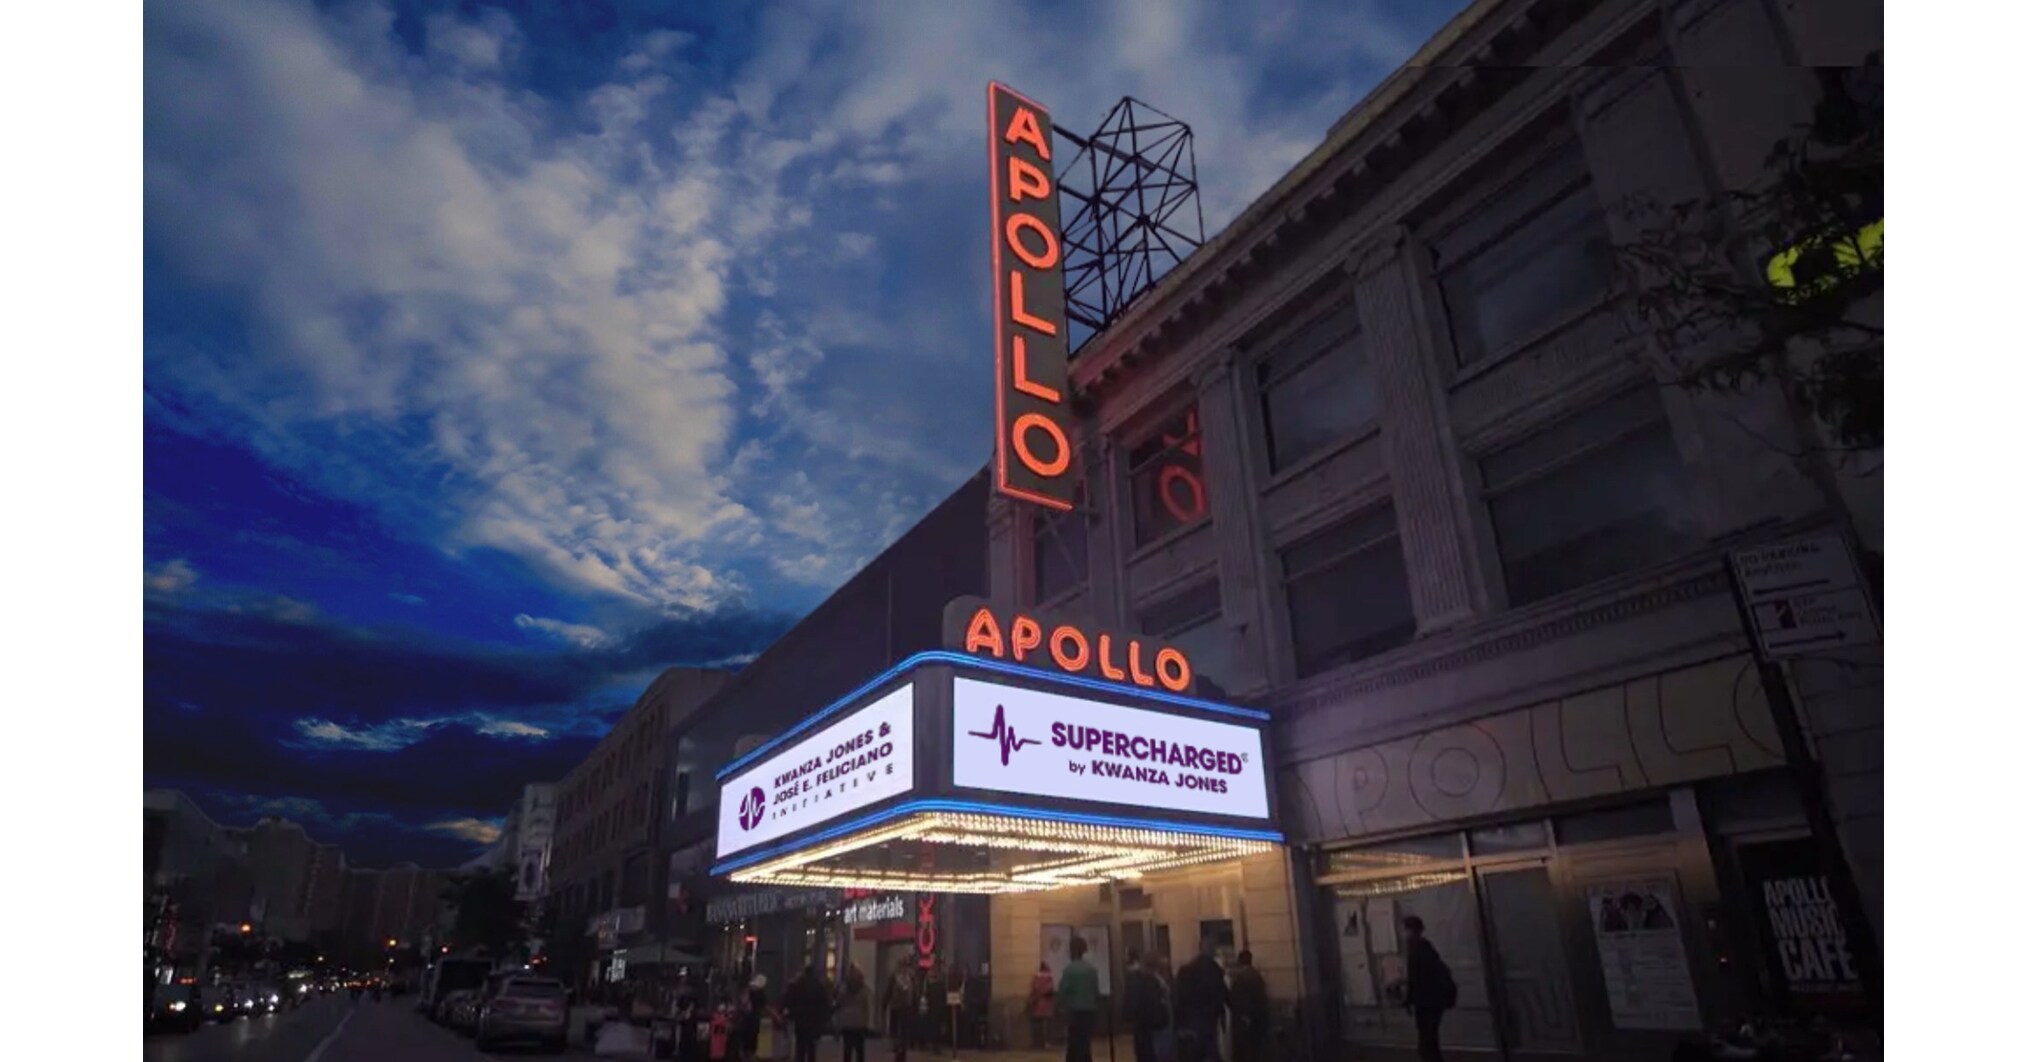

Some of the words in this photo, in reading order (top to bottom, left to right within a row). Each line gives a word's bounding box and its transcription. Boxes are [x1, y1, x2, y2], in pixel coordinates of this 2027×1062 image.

[1004, 105, 1071, 477] APOLLO
[966, 608, 1191, 691] APOLLO
[772, 780, 799, 806] JOSÉ
[802, 780, 813, 793] E.
[816, 742, 893, 787] FELICIANO
[773, 756, 822, 789] KWANZA
[826, 729, 873, 764] JONES
[879, 721, 892, 738] &
[1068, 760, 1086, 776] by
[1091, 760, 1170, 786] KWANZA
[1174, 773, 1228, 794] JONES
[772, 763, 894, 820] INITIATIVE
[858, 894, 904, 921] materials
[1768, 900, 1845, 939] MUSIC
